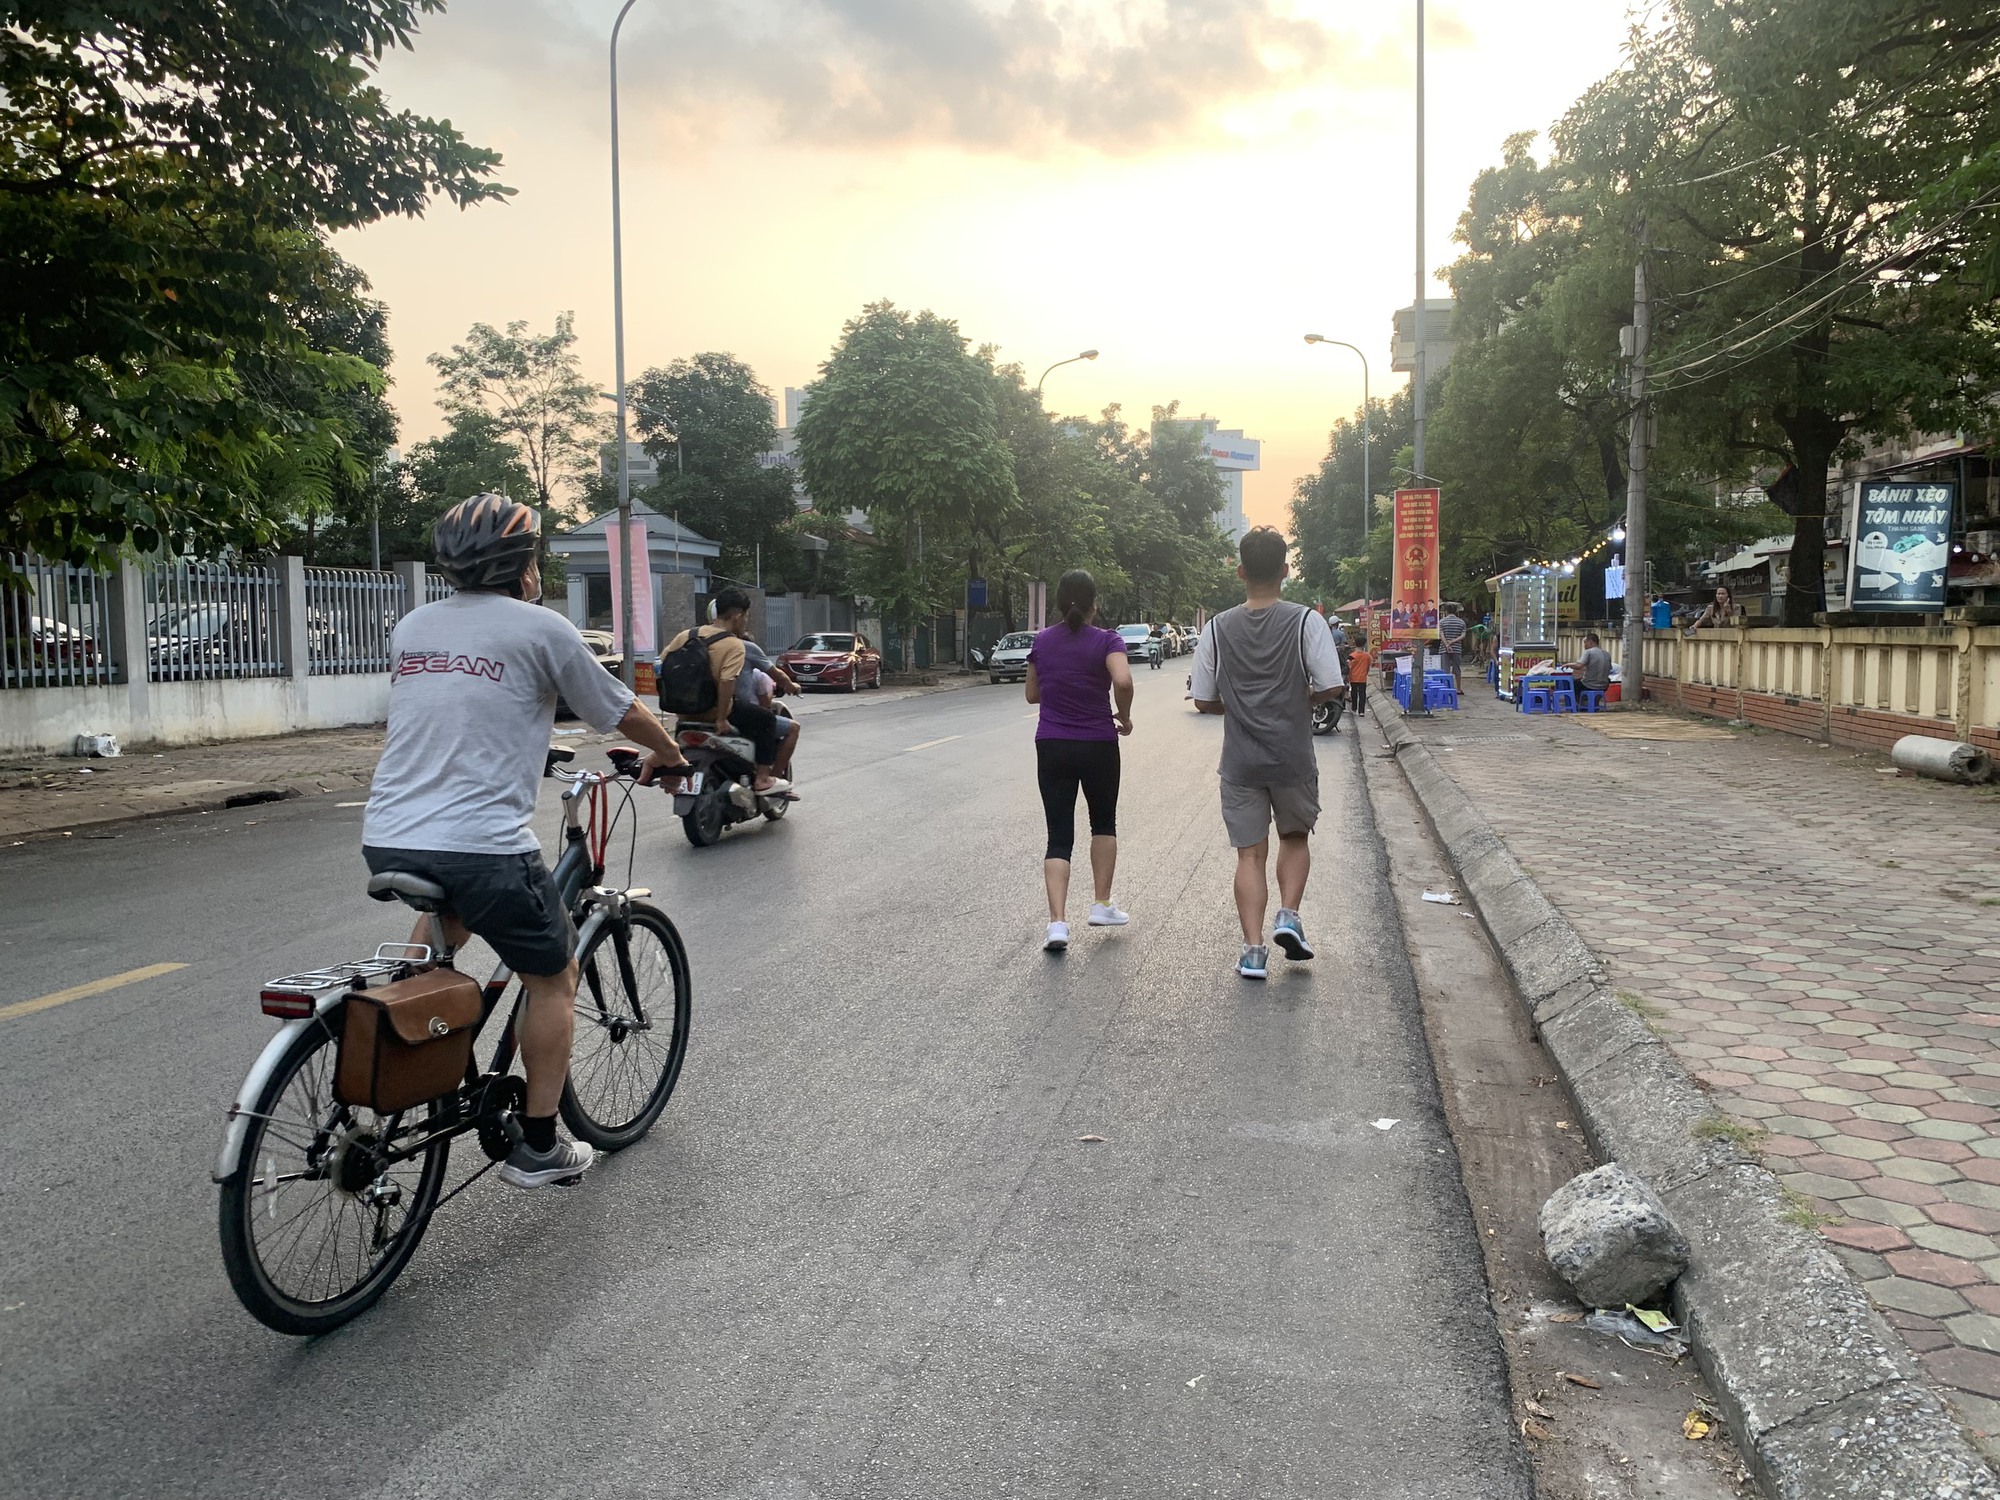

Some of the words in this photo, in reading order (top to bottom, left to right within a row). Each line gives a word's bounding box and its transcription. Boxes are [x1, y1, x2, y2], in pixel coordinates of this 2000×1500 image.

[1868, 486, 1912, 503] BÁNH
[1914, 485, 1949, 503] XÈO
[1865, 507, 1900, 524] TÔM
[1902, 506, 1948, 525] NHẢY
[1403, 579, 1428, 590] 09-11
